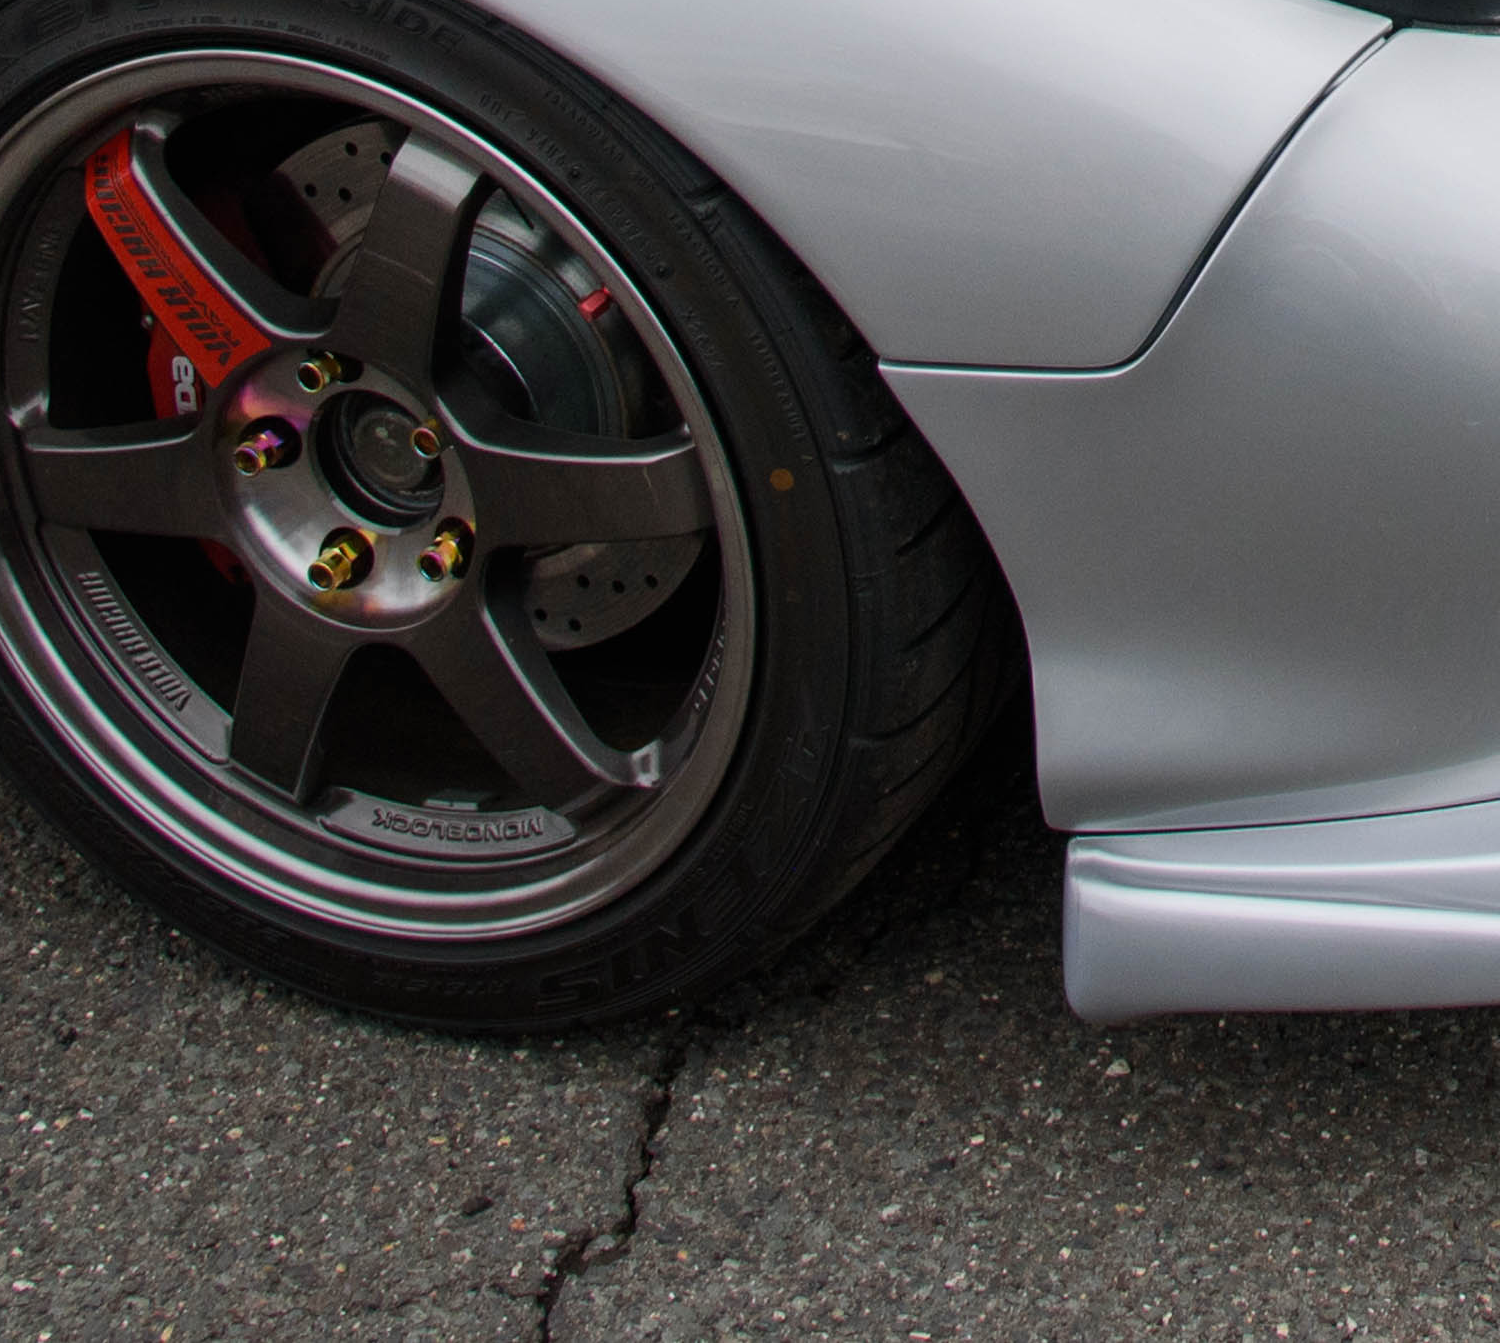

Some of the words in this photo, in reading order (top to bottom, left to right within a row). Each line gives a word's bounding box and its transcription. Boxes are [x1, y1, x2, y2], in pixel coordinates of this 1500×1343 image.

[155, 285, 232, 367] VOLK
[76, 571, 148, 657] RACING
[145, 652, 189, 712] VOLK
[370, 807, 545, 844] MONOBLOCK
